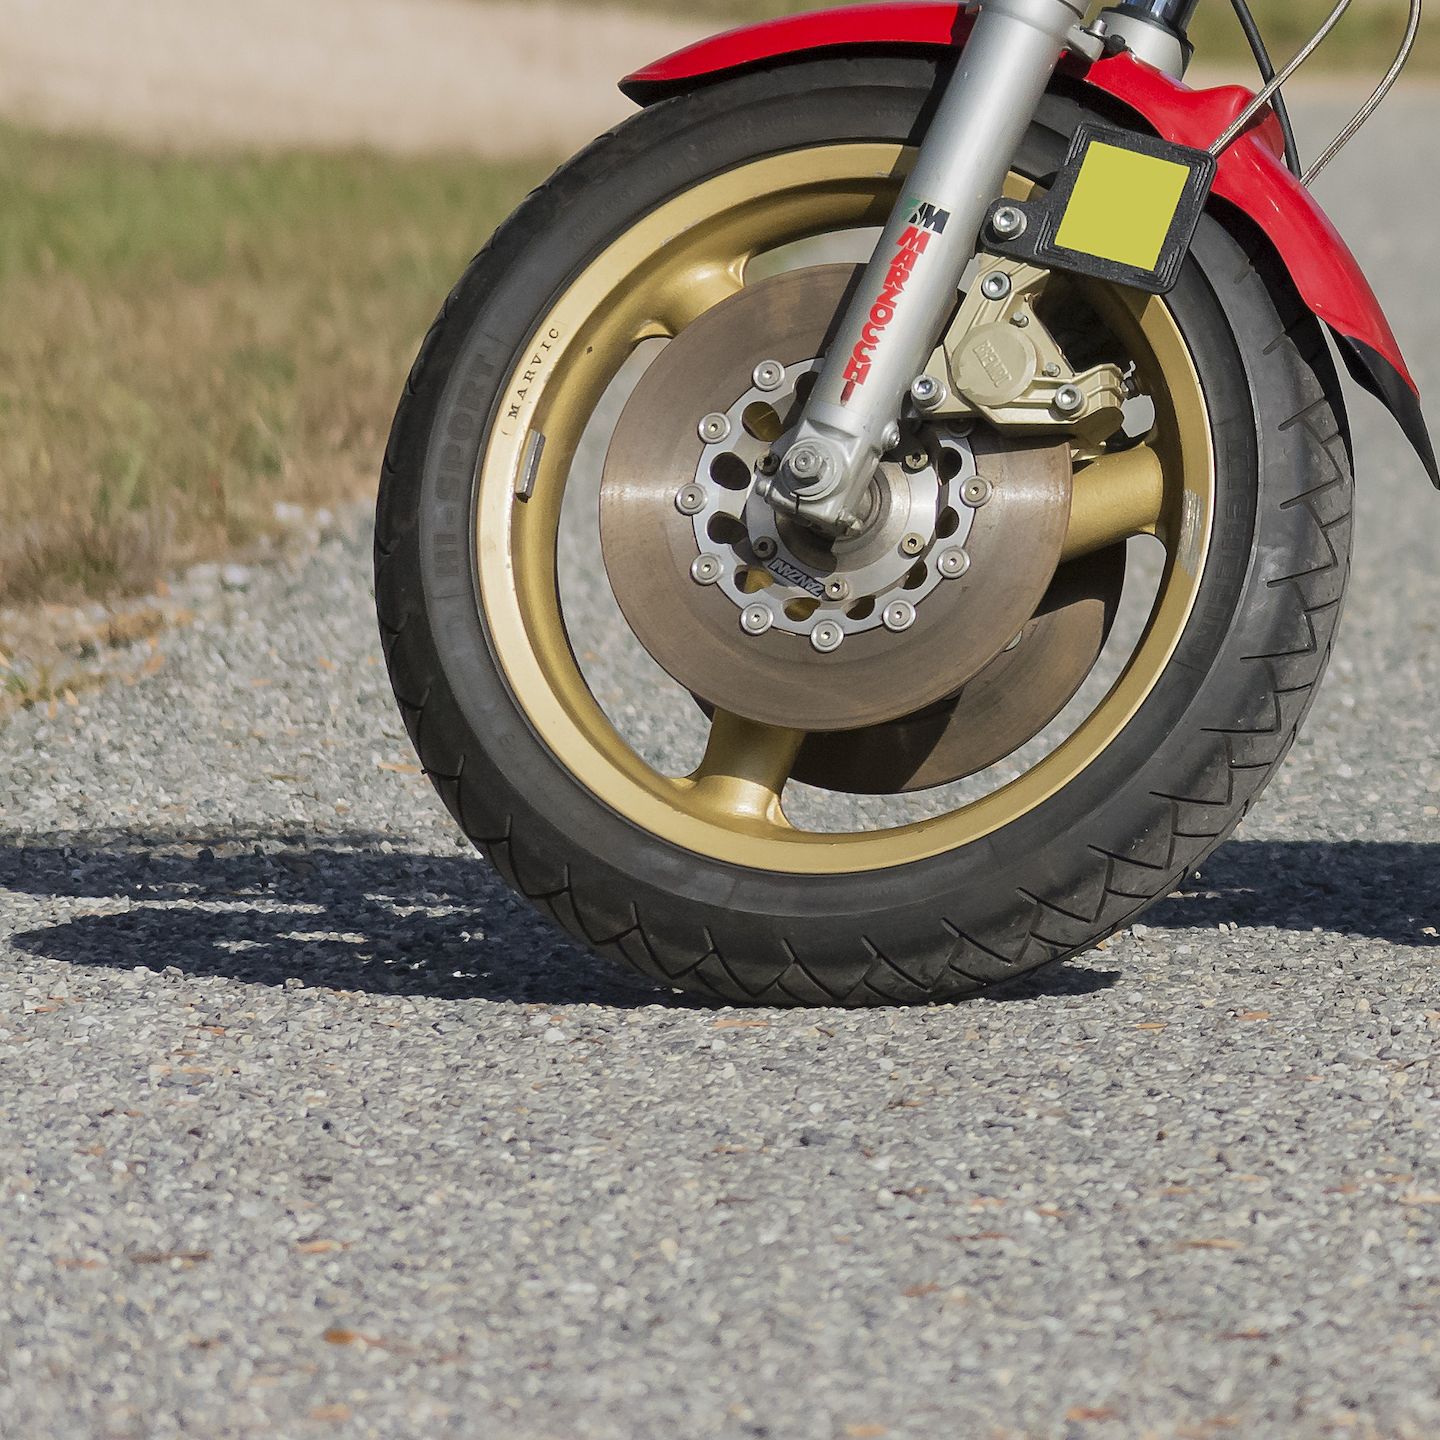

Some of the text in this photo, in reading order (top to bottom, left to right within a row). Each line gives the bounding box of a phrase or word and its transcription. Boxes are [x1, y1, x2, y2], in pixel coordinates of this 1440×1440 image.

[840, 226, 932, 407] MARZOCCHI
[507, 328, 559, 419] MARVIC
[768, 559, 824, 596] ZANZANI
